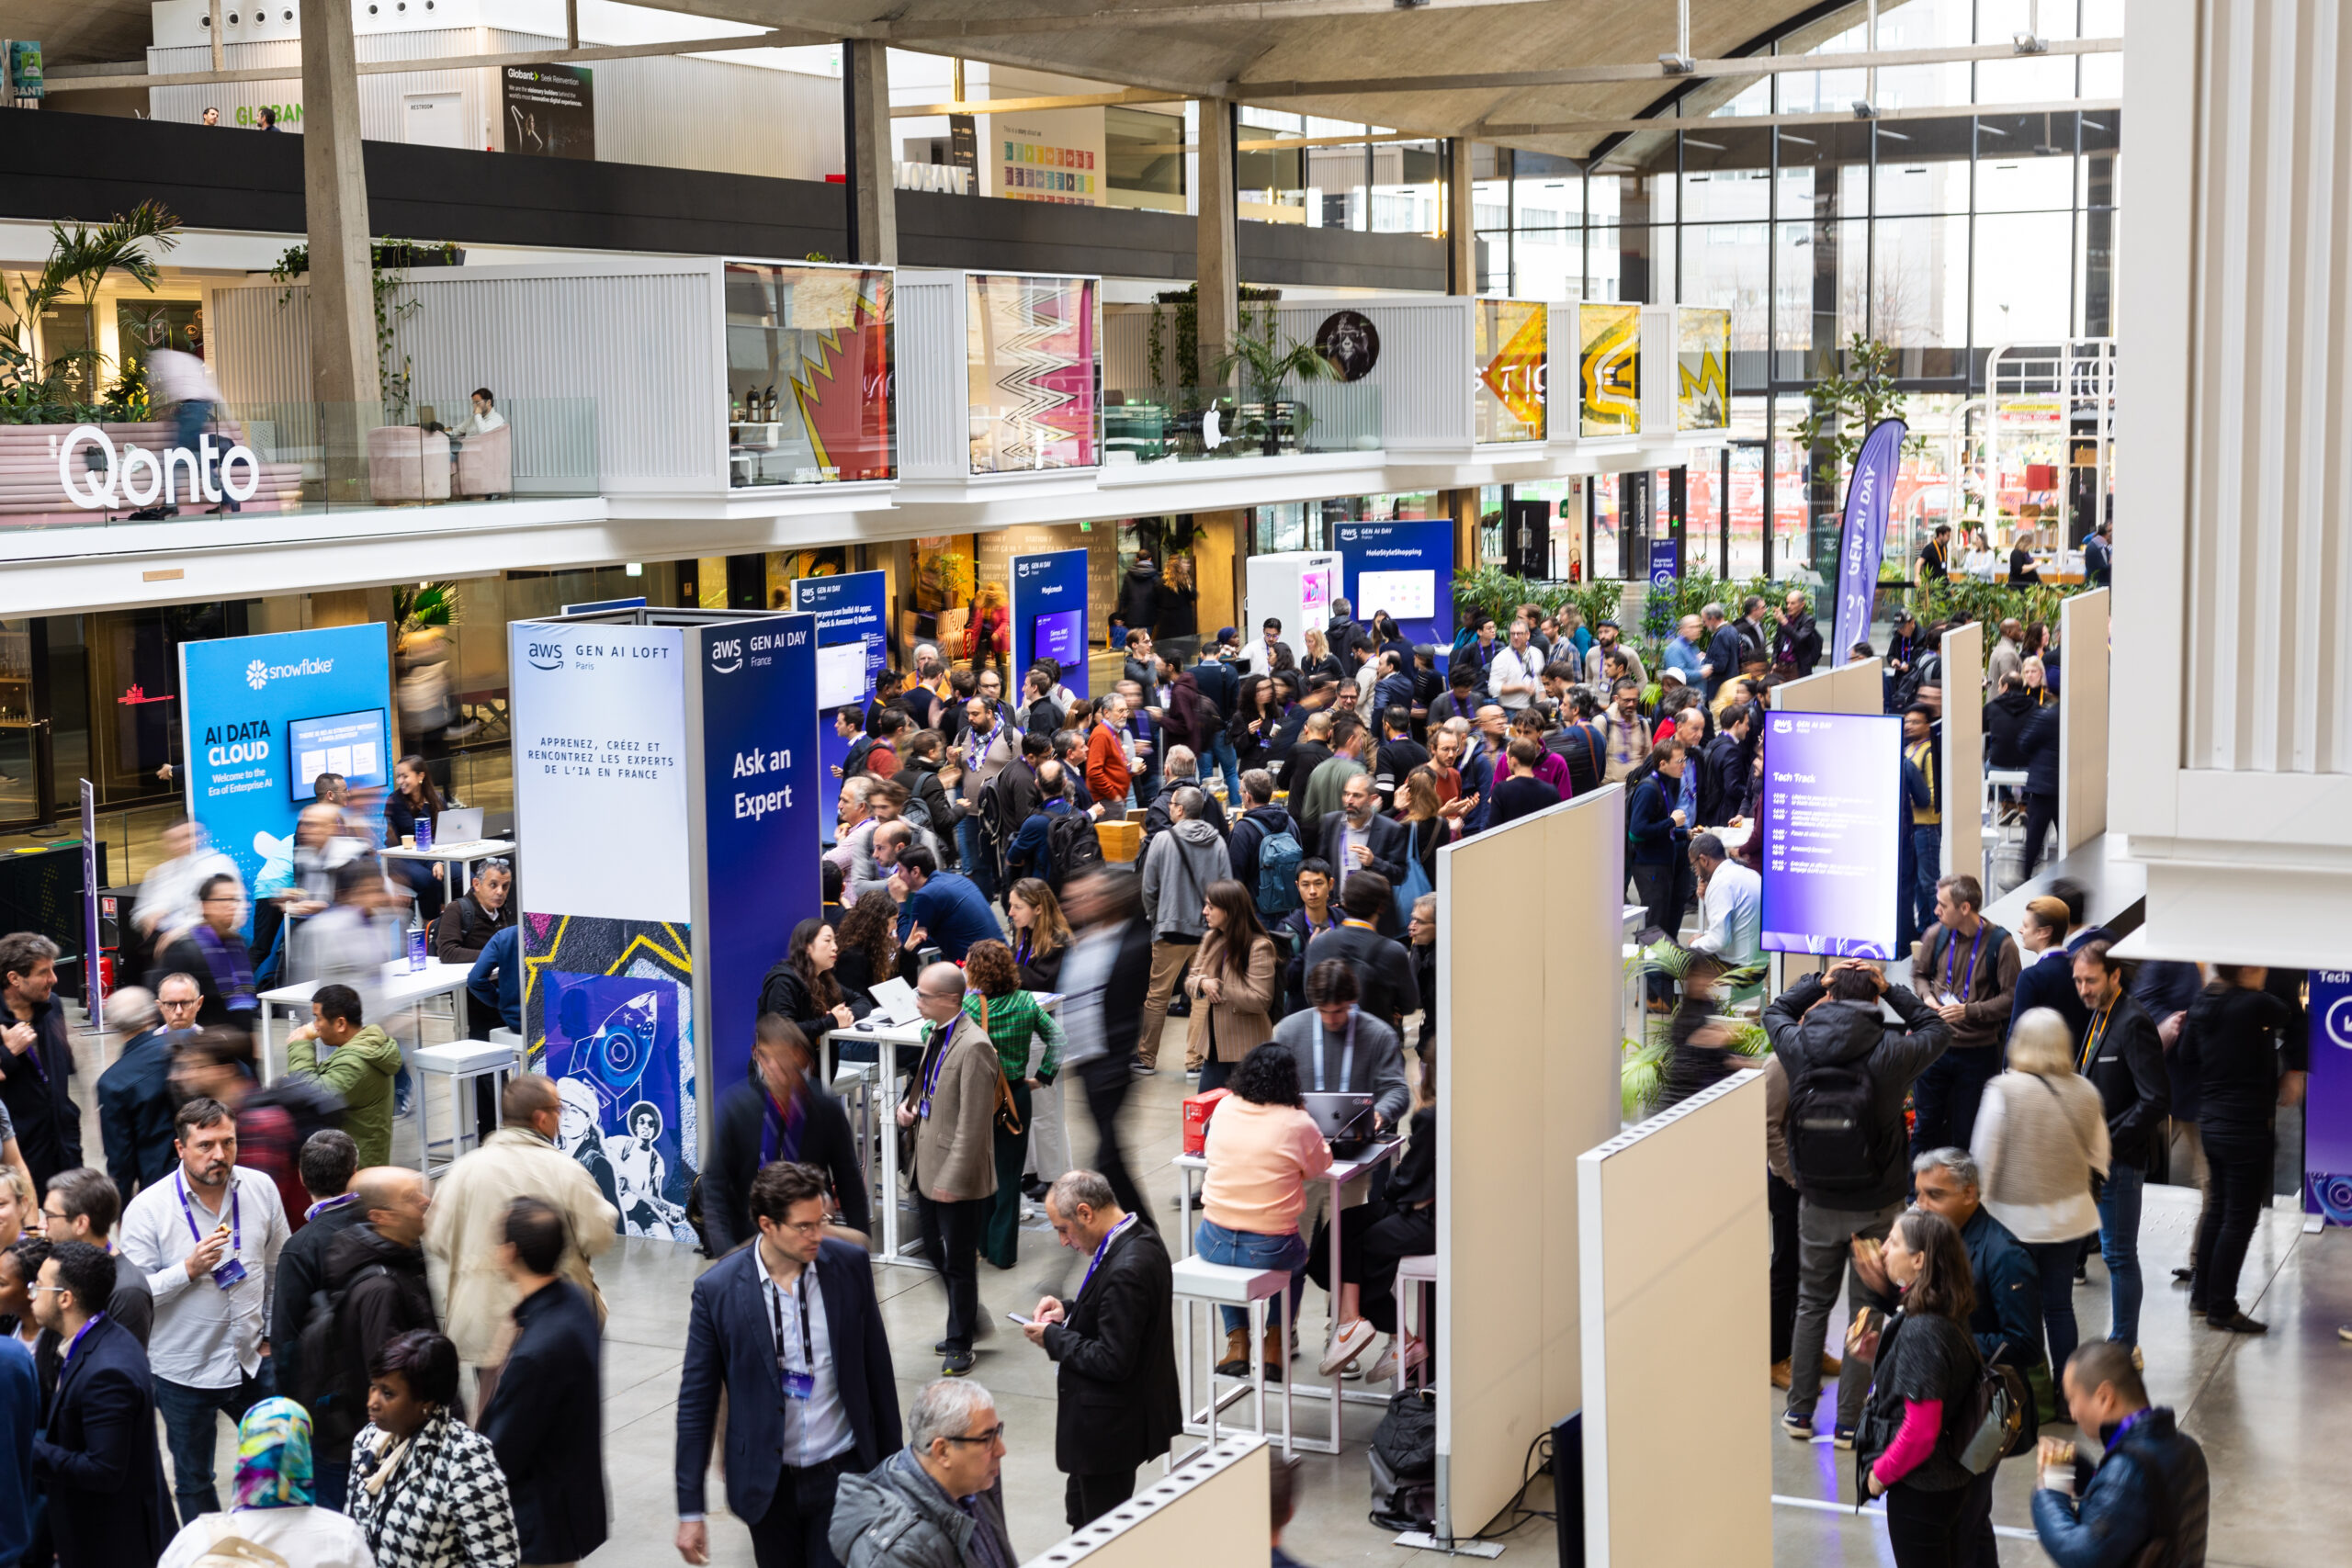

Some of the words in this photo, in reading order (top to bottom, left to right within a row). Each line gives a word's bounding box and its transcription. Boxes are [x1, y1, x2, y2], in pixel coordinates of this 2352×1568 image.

[508, 68, 534, 81] Globant
[540, 73, 552, 83] Seek
[553, 75, 579, 86] Reinvention
[236, 103, 303, 125] GLBAN
[59, 425, 259, 509] Qonto
[1860, 465, 1876, 505] DAY
[1856, 511, 1867, 531] AI
[1366, 548, 1422, 557] HoloStyleShopping
[817, 586, 826, 594] GEN
[832, 584, 841, 592] DAY
[842, 606, 854, 615] build
[835, 617, 854, 626] Amazon
[859, 615, 877, 623] Business
[529, 642, 562, 658] aws
[576, 645, 603, 657] GEN
[611, 646, 625, 657] AI
[633, 647, 669, 659] LOFT
[712, 638, 741, 660] aws
[750, 635, 772, 651] GEN
[775, 634, 785, 648] AI
[787, 630, 807, 646] DAY
[269, 658, 333, 680] snowflake
[576, 661, 594, 671] Paris
[751, 655, 772, 667] France
[205, 726, 220, 745] AI
[226, 720, 270, 741] DATA
[209, 740, 269, 766] CLOUD
[540, 738, 598, 750] APPRENEZ,
[607, 739, 639, 751] CRÉEZ
[648, 742, 660, 752] ET
[528, 750, 594, 762] RENCONTREZ
[601, 754, 620, 764] LES
[628, 756, 673, 766] EXPERTS
[733, 748, 765, 779] Ask
[770, 750, 791, 772] an
[212, 772, 244, 784] Welcome
[245, 770, 254, 779] to
[254, 768, 266, 777] the
[545, 765, 557, 774] DE
[565, 766, 590, 776] L'IA
[598, 768, 610, 777] EN
[618, 769, 658, 780] FRANCE
[1773, 773, 1792, 782] Tech
[1794, 773, 1815, 783] Track
[209, 785, 220, 796] Era
[221, 784, 229, 795] of
[230, 781, 263, 795] Enterprise
[265, 779, 272, 788] AI
[735, 785, 792, 821] Expert
[2319, 970, 2350, 984] Tech
